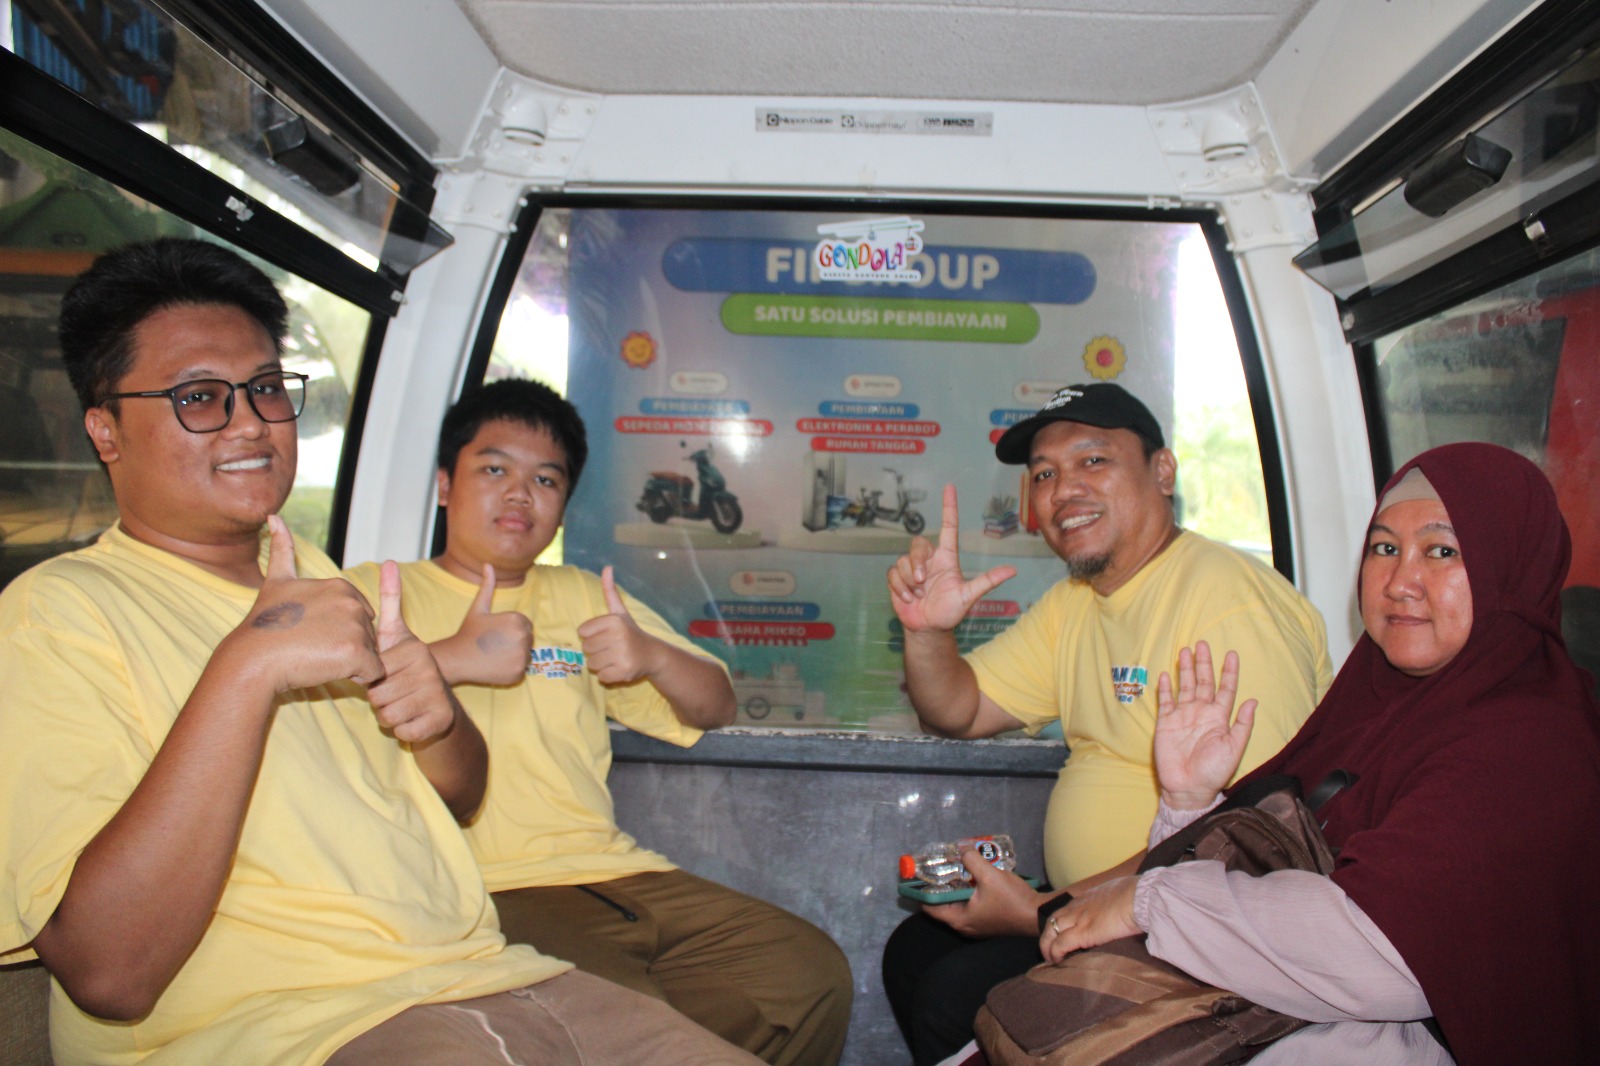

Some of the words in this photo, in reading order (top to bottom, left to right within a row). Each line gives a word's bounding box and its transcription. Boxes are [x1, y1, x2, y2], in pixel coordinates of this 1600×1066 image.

[819, 242, 905, 271] GONDOLA
[754, 305, 805, 323] SATU
[809, 307, 879, 327] SOLUSI
[883, 308, 1007, 330] PEMBIAYAAN
[831, 403, 905, 415] PEMBIAYAAN
[622, 420, 670, 432] SEPEDA
[802, 421, 872, 433] ELEKTRONIK
[875, 423, 883, 433] &
[885, 423, 937, 434] PERABOT
[826, 439, 867, 449] RUMAH
[871, 441, 917, 451] TANGGA
[720, 605, 805, 616] PEMBIAYAAN
[763, 625, 807, 637] MIKRO
